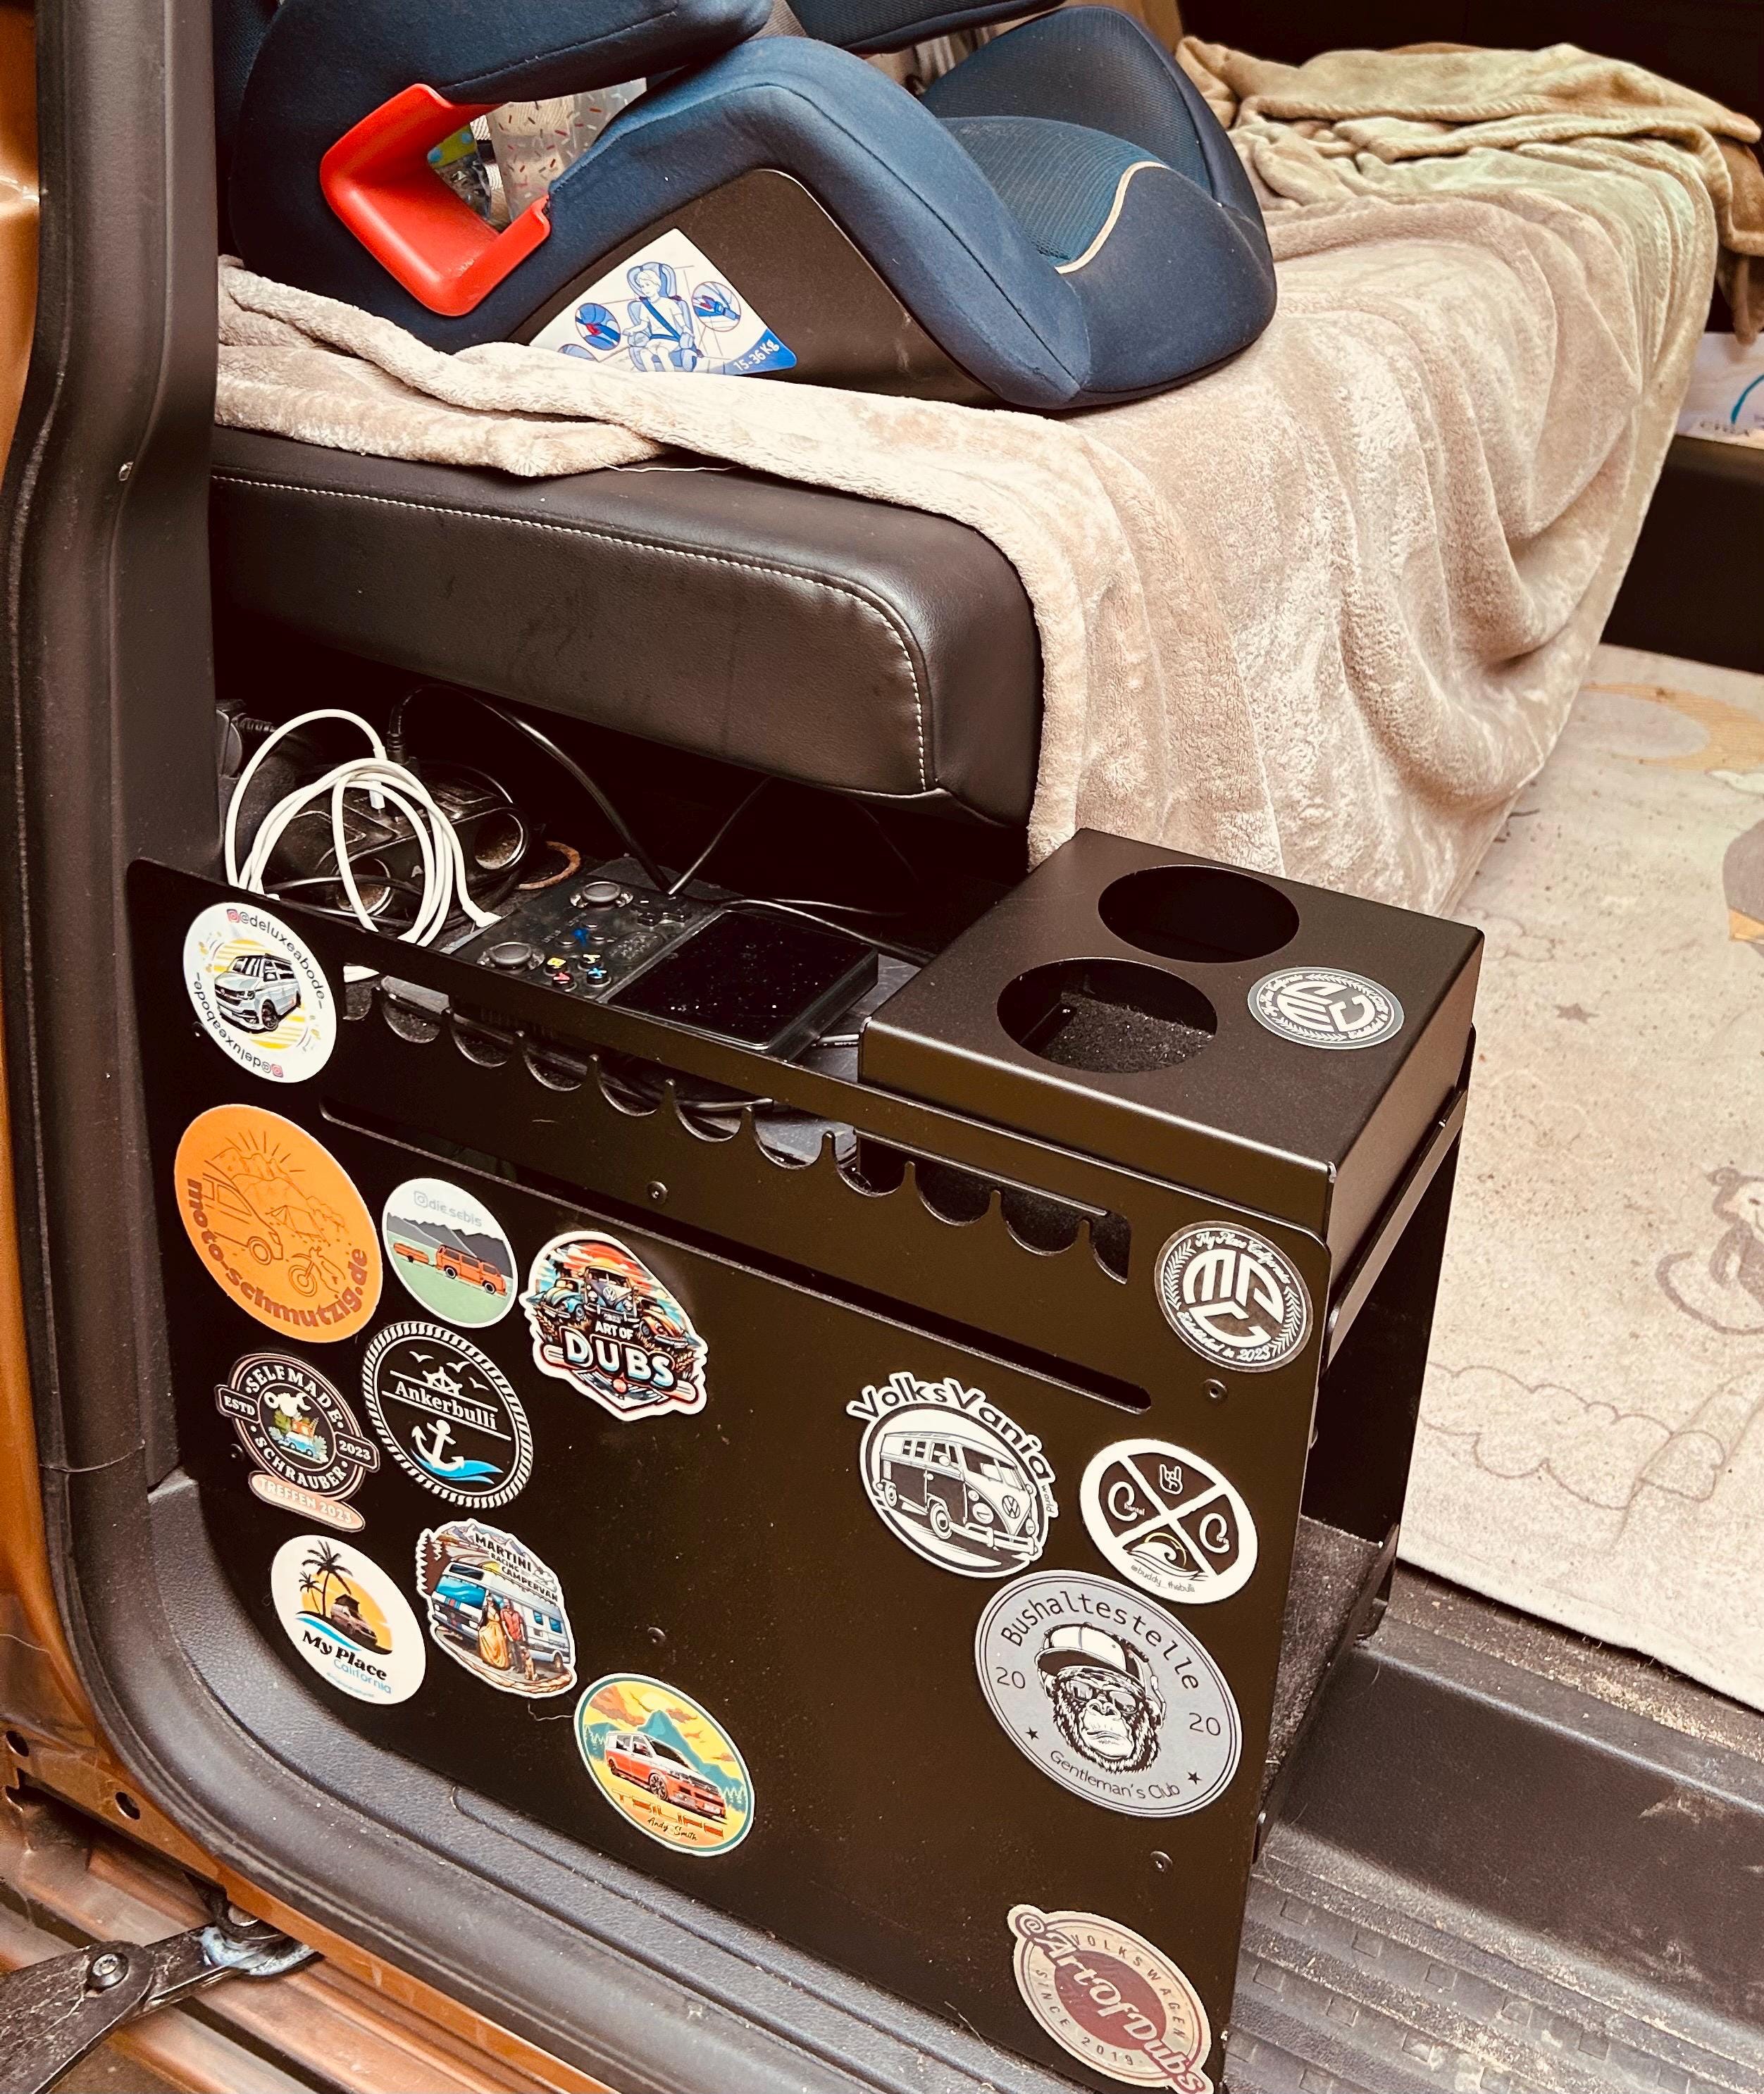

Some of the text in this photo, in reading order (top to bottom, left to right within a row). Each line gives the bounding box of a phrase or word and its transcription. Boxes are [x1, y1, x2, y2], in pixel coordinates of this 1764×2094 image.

[733, 339, 780, 371] 15-36 Kg
[595, 1321, 634, 1340] ART OF
[564, 1330, 674, 1388] DUBS
[223, 1395, 256, 1416] ESTD
[247, 1364, 344, 1423] SELFMADE
[395, 1381, 497, 1431] Ankerbulli
[339, 1440, 371, 1461] 2023
[851, 1376, 1051, 1480] VolksVania
[254, 1436, 347, 1490] SCHRAUBER
[260, 1478, 353, 1524] TREFFEN 2023
[475, 1533, 532, 1572] MARTINI
[490, 1552, 520, 1573] RACING
[502, 1566, 558, 1602] CAMPERVAN
[302, 1630, 387, 1681] My Place
[1000, 1590, 1199, 1690] Bushaltestelle
[333, 1659, 392, 1695] California
[995, 1666, 1221, 1736] 20 20
[1050, 1750, 1180, 1799] Gentleman's Club
[647, 1816, 699, 1841] Andy Smith
[1070, 1933, 1186, 2039] VOLKSWAGEN
[1035, 1969, 1133, 2066] SINCE 2019
